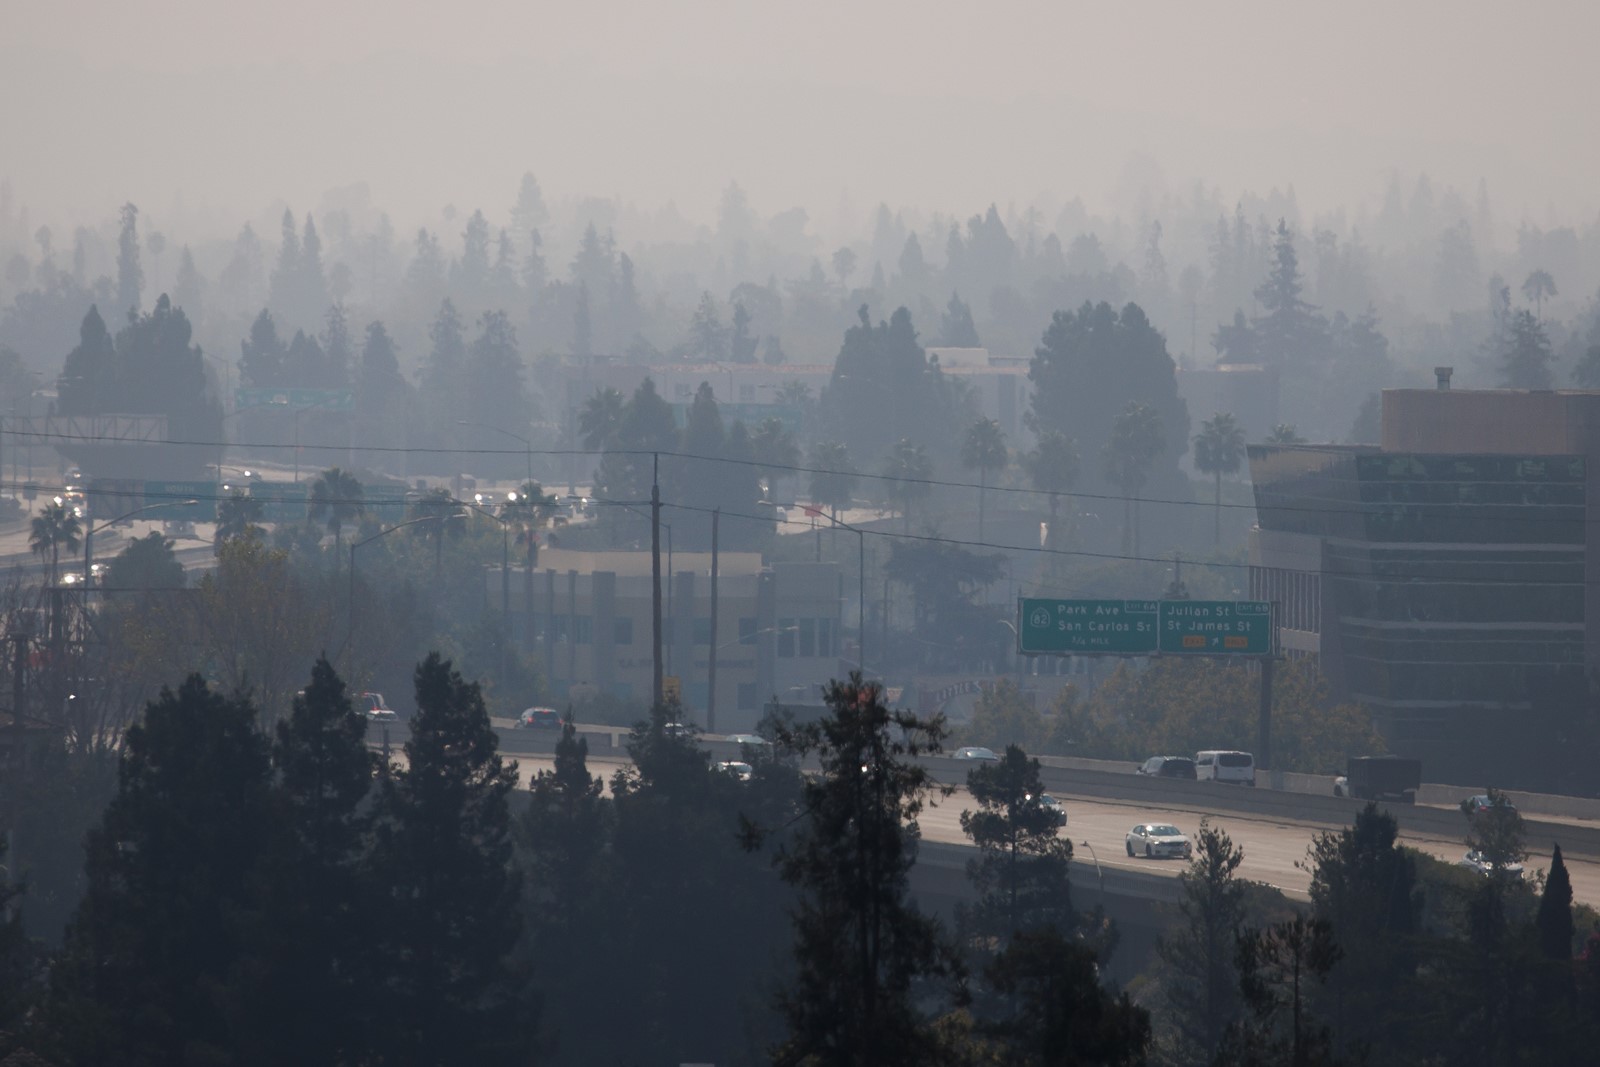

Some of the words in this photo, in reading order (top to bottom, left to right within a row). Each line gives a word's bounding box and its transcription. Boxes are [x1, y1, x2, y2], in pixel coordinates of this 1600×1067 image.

[1057, 604, 1087, 614] Park
[1095, 605, 1119, 615] Ave
[1167, 605, 1209, 616] Julian
[1215, 606, 1230, 617] St
[1255, 604, 1268, 612] 6B
[1033, 615, 1047, 625] 82
[1058, 620, 1081, 631] San
[1088, 621, 1129, 631] Carlos
[1136, 621, 1151, 631] St
[1167, 620, 1181, 630] St
[1188, 620, 1230, 631] James
[1237, 621, 1251, 631] St
